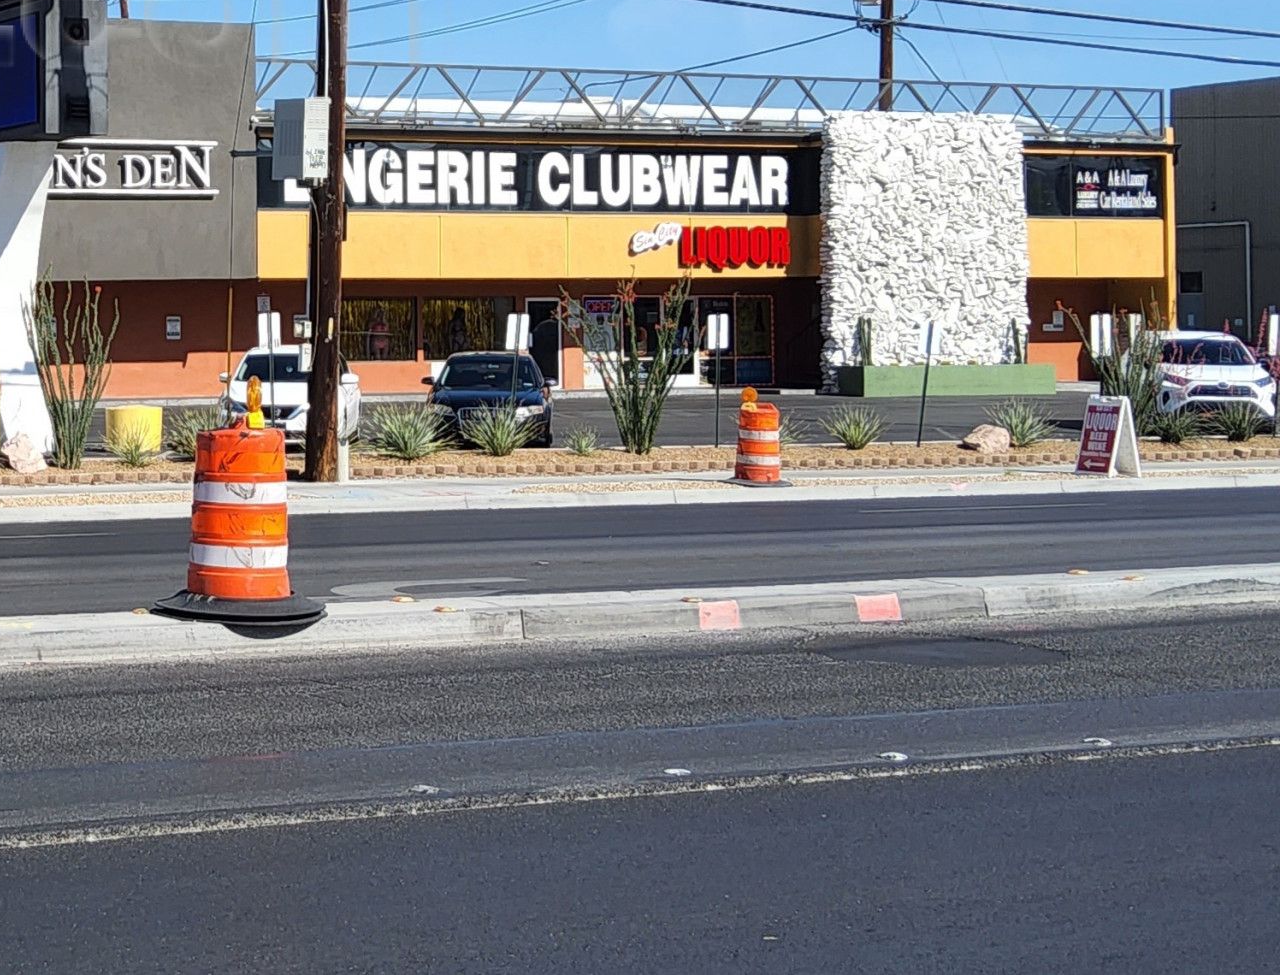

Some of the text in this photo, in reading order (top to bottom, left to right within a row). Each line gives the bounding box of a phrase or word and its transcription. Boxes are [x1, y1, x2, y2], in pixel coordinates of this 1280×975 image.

[53, 145, 214, 188] N'S DEN
[284, 148, 789, 206] NGERIE CLUBWEAR
[635, 226, 679, 249] Sin City
[680, 225, 792, 269] LIQUOR
[1086, 413, 1118, 431] LIQUOR
